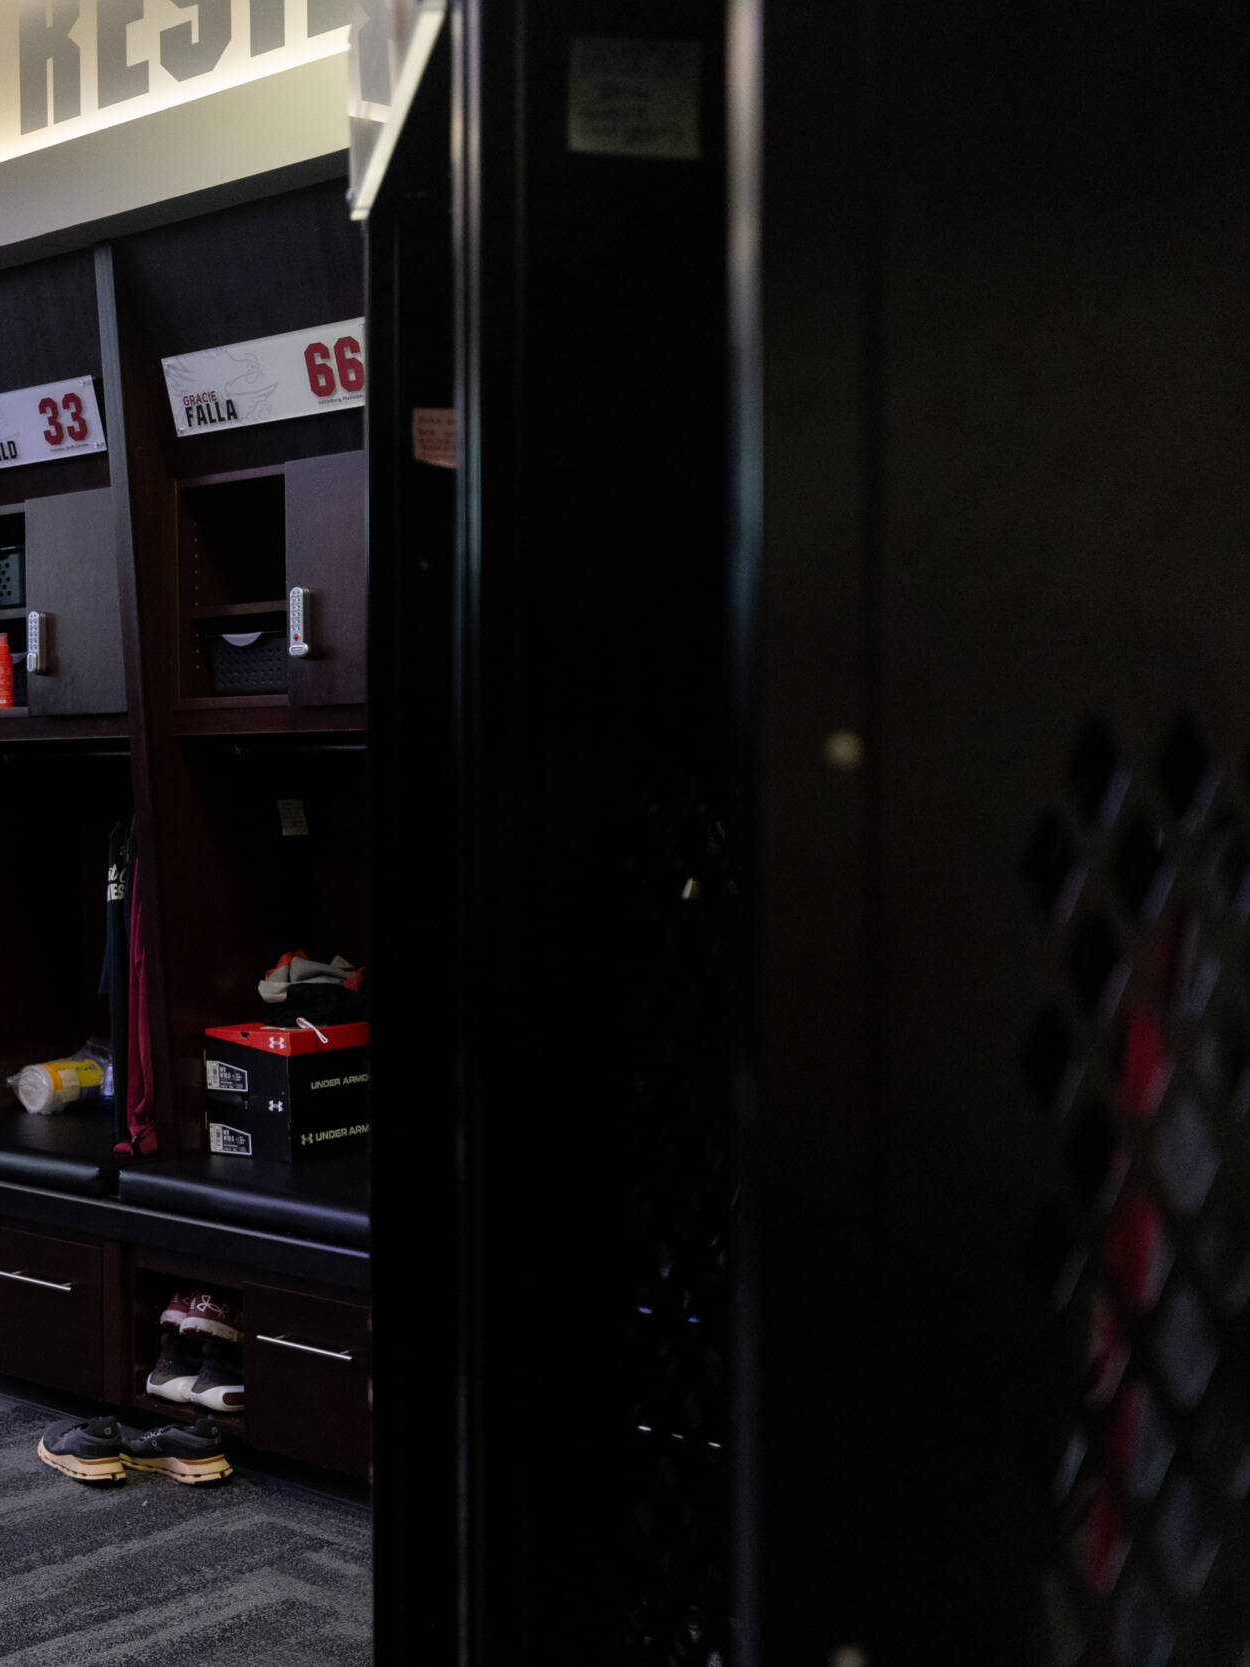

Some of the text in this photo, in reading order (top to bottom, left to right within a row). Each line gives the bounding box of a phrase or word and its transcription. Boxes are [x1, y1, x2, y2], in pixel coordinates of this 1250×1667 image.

[304, 335, 365, 397] 66
[182, 390, 218, 407] GRACIE
[38, 392, 88, 446] 33
[185, 399, 238, 427] FALLA
[310, 1078, 341, 1090] UNDER
[315, 1127, 348, 1142] UNDER
